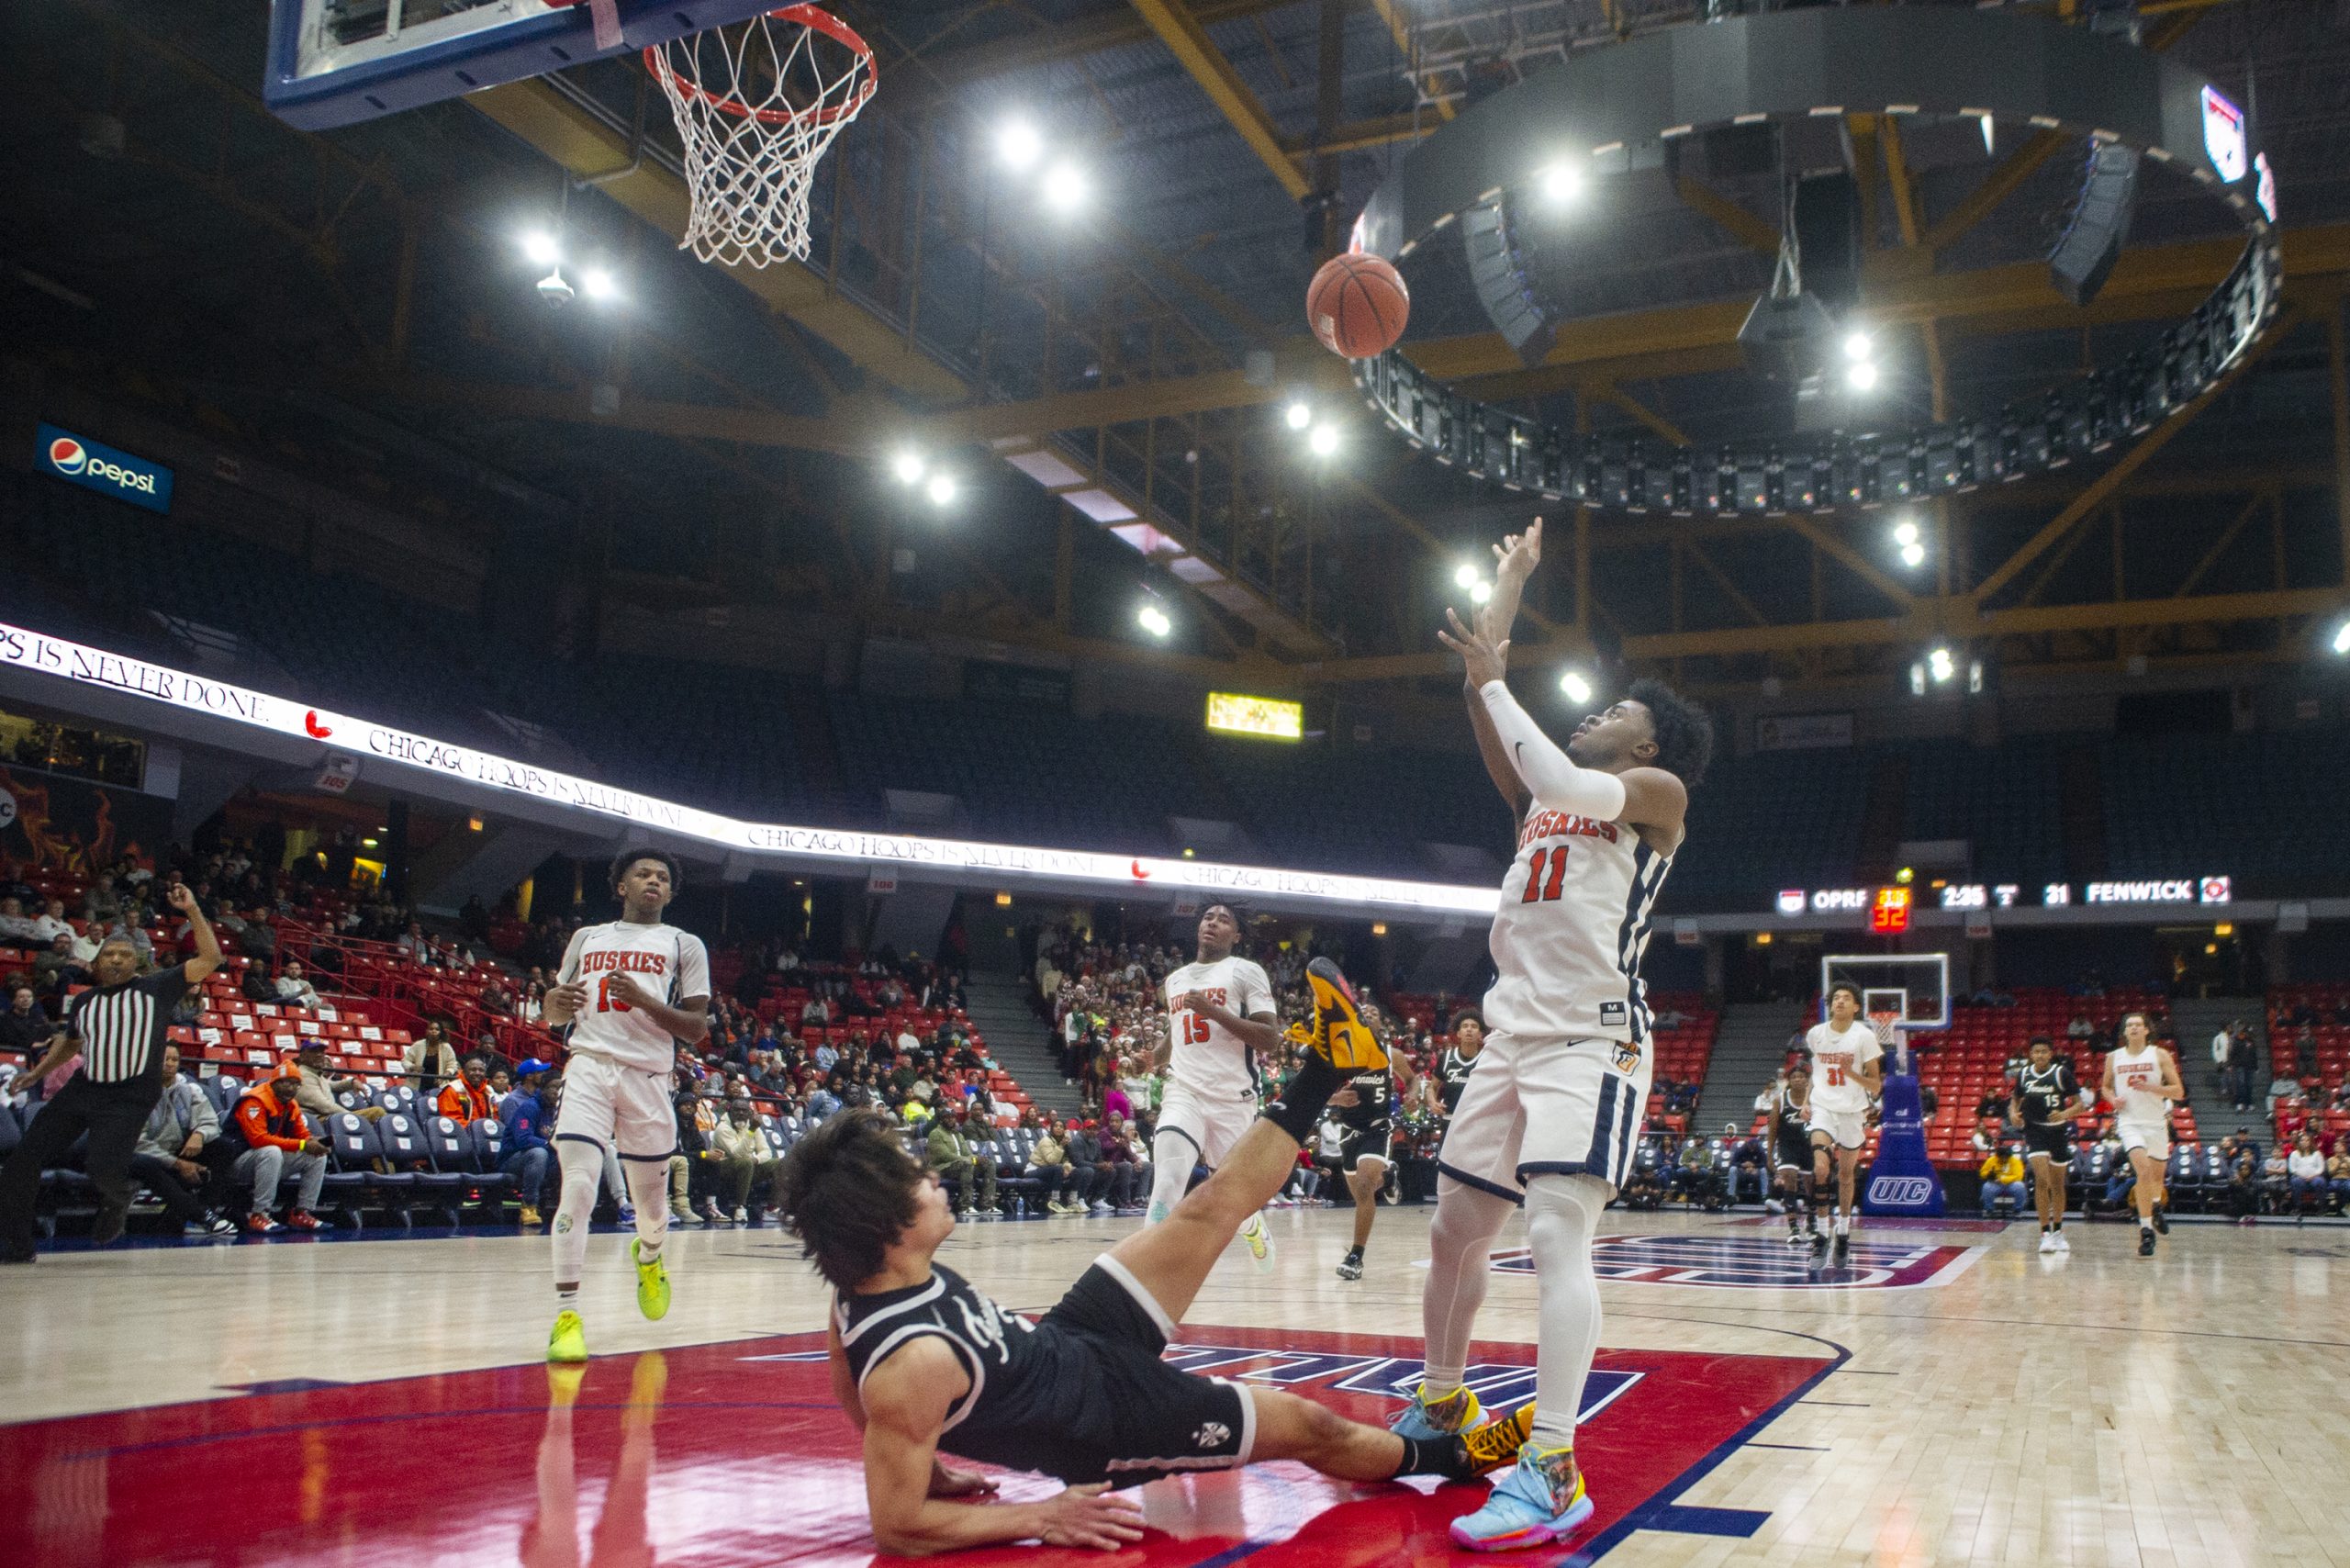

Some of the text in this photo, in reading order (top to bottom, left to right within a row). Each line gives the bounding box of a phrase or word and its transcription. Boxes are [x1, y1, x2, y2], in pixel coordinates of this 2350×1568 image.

[87, 458, 156, 494] pepsi
[36, 639, 62, 668] IS
[71, 649, 173, 700] NEVER
[368, 730, 474, 774] CHICAGO
[477, 756, 548, 793] HOOPS
[747, 827, 856, 853] CHICAGO
[859, 835, 934, 860] HOOPS
[941, 844, 958, 860] IS
[1181, 864, 1273, 889] CHICAGO
[1275, 873, 1340, 895] HOOPS
[1522, 845, 1570, 903] 11
[1813, 889, 1867, 909] OPRF
[2087, 879, 2192, 902] FENWICK
[1875, 904, 1905, 926] 32
[582, 950, 666, 976] HUSKIES
[1183, 1013, 1211, 1046] 15
[1374, 1087, 1386, 1103] 5
[2044, 1094, 2061, 1108] 15
[1868, 1177, 1931, 1204] UIC
